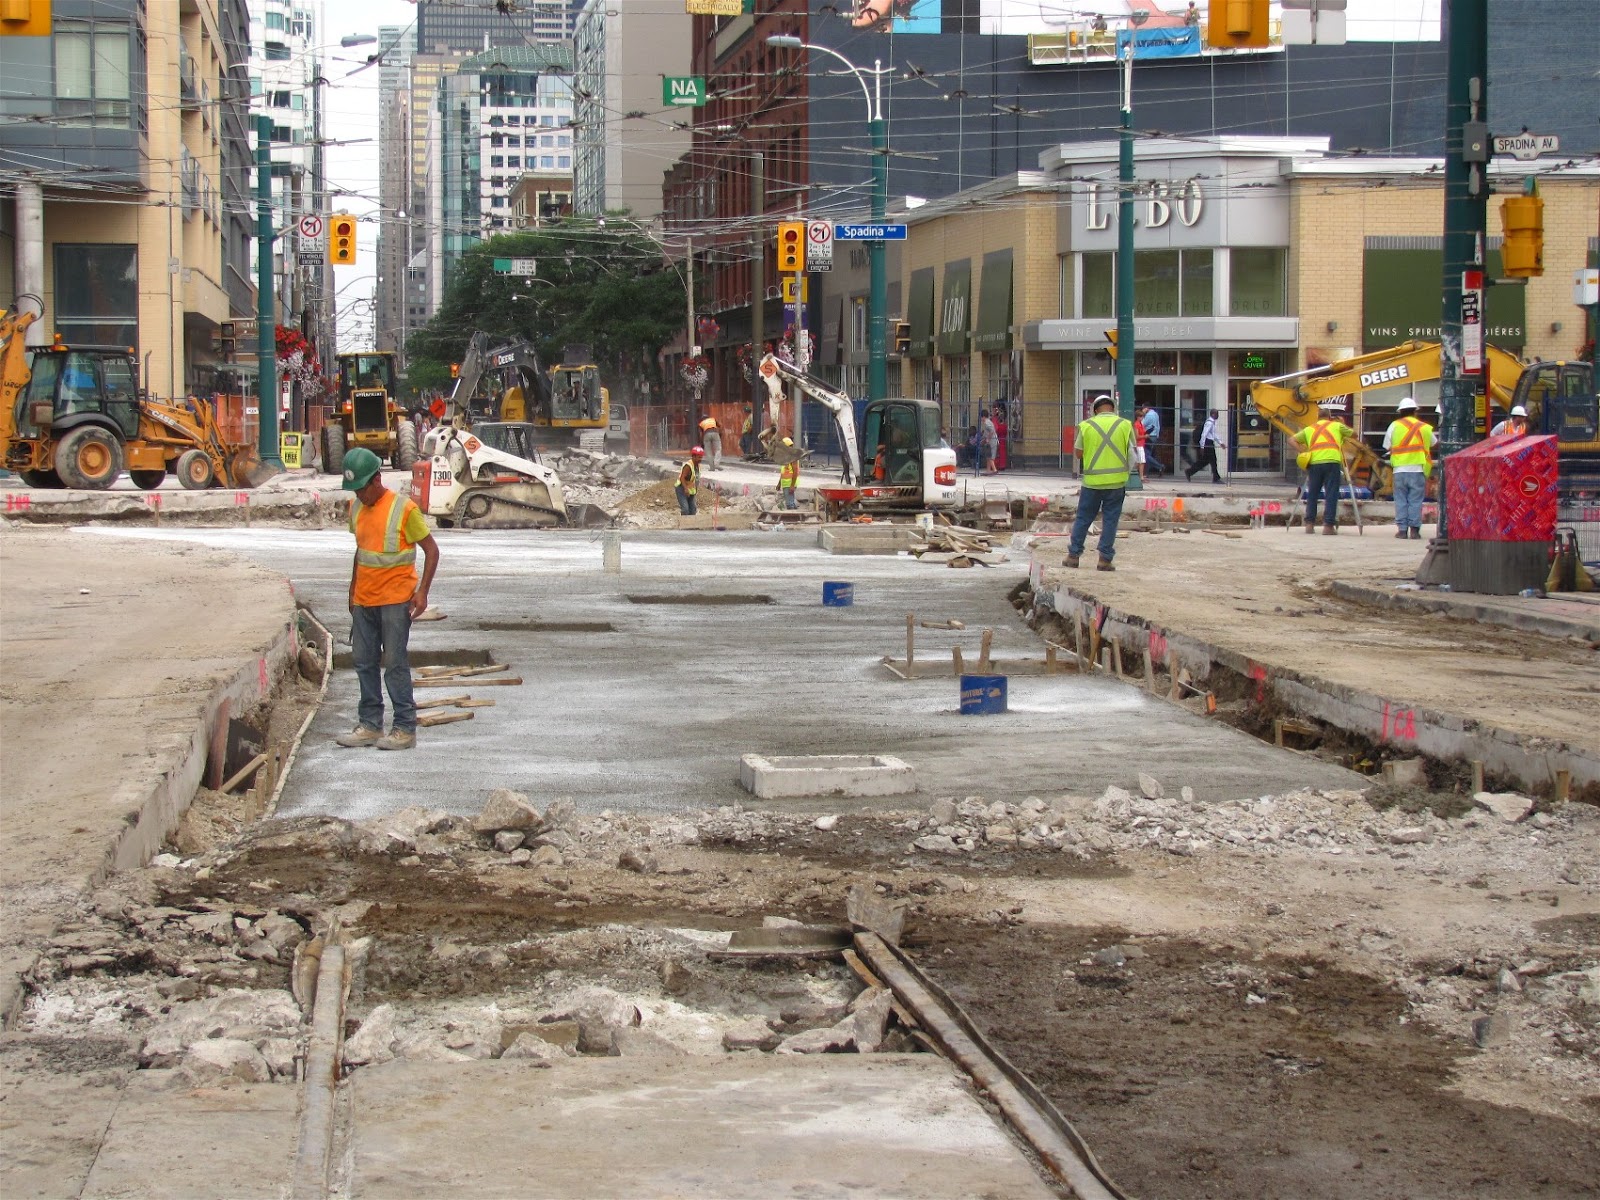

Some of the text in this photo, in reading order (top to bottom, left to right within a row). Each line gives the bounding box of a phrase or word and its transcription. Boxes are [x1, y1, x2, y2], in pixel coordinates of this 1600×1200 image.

[687, 3, 739, 12] ELECTRICALLY
[671, 80, 698, 95] NA
[1498, 139, 1536, 150] SPADINA
[844, 226, 884, 236] Spadina
[1101, 301, 1270, 313] DOVER THE ORLD
[942, 297, 964, 333] LCBO
[1058, 326, 1193, 337] WINE BEER
[1370, 328, 1397, 336] VINS
[1408, 328, 1442, 336] SPIRIT
[497, 353, 515, 365] DEERE
[1360, 365, 1408, 387] DEERE
[151, 410, 176, 426] CASE
[433, 471, 451, 480] T300
